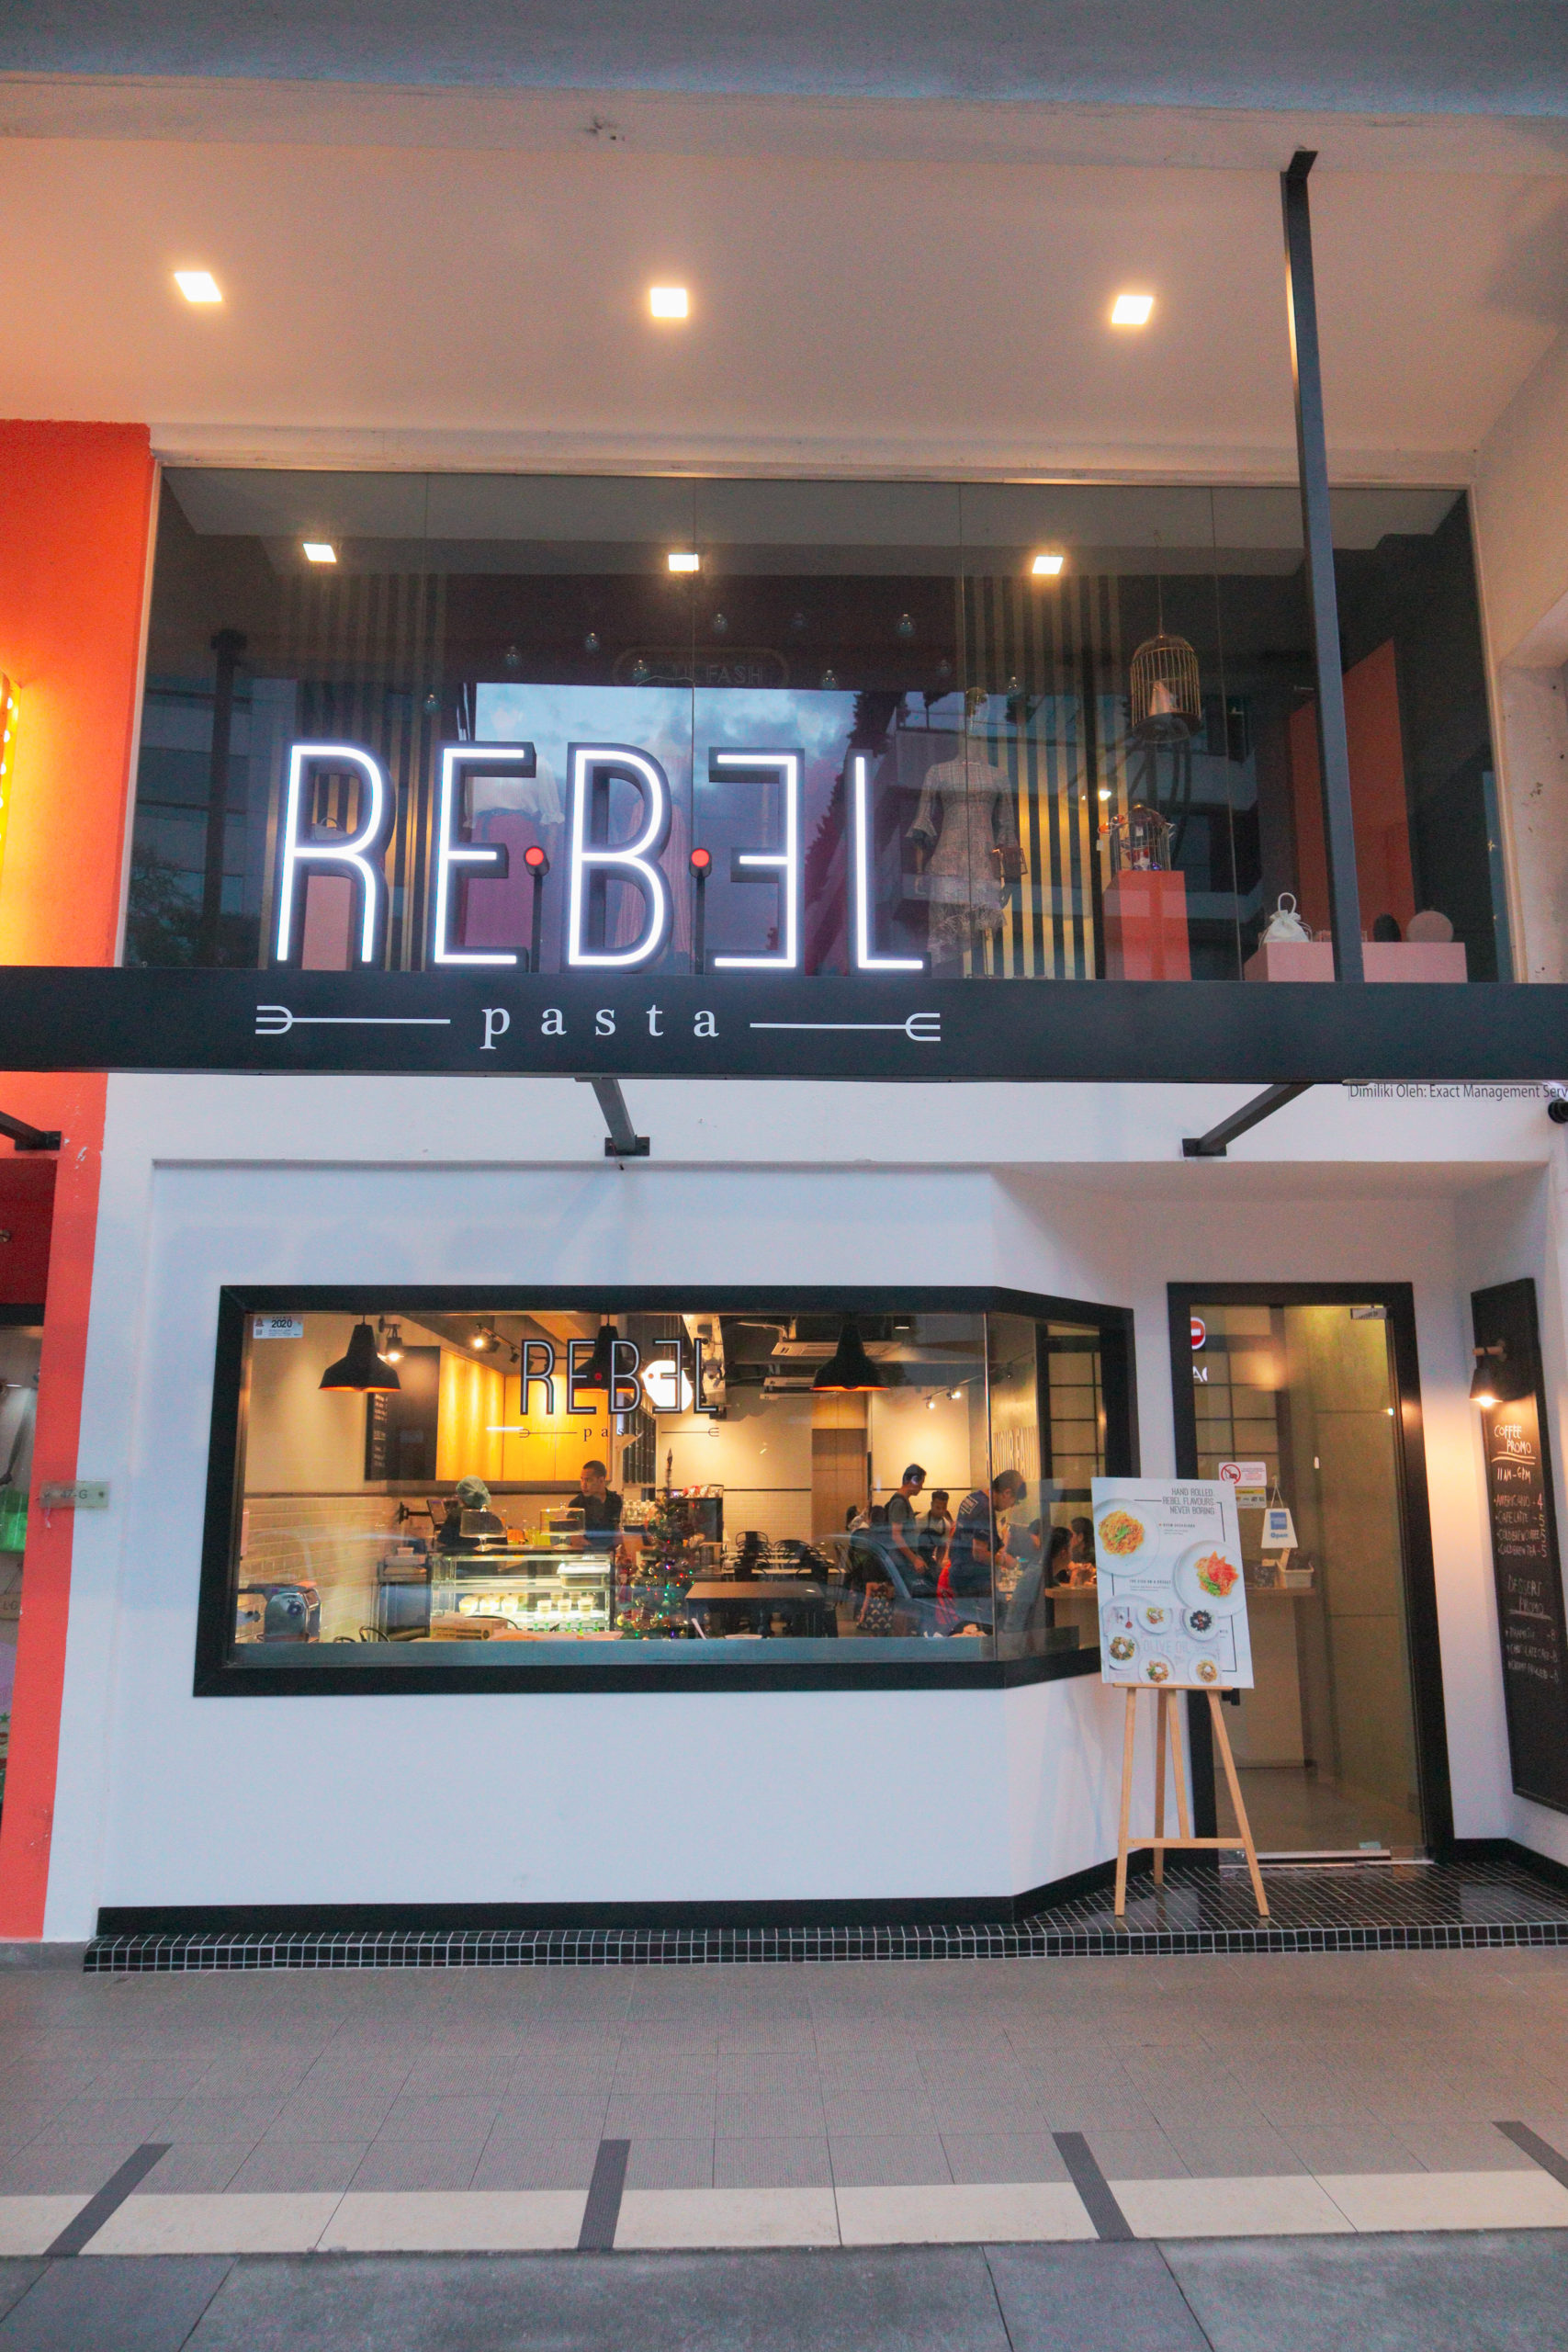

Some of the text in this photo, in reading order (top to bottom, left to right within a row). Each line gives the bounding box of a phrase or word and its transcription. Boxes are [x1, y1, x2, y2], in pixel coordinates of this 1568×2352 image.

[276, 741, 928, 972] REBEL
[479, 1003, 721, 1050] pasta
[1349, 1083, 1393, 1098] Dimiliki
[1396, 1083, 1427, 1098] Oleh:
[1429, 1084, 1460, 1098] Exact
[1463, 1084, 1540, 1101] Management
[271, 1318, 293, 1329] 2020
[520, 1338, 720, 1415] REBEL
[1494, 1424, 1522, 1440] COFFEE
[1506, 1439, 1532, 1454] PROMO
[1171, 1487, 1189, 1496] HAND
[1162, 1496, 1181, 1505] REBEL
[1169, 1506, 1215, 1515] NEVER BORING
